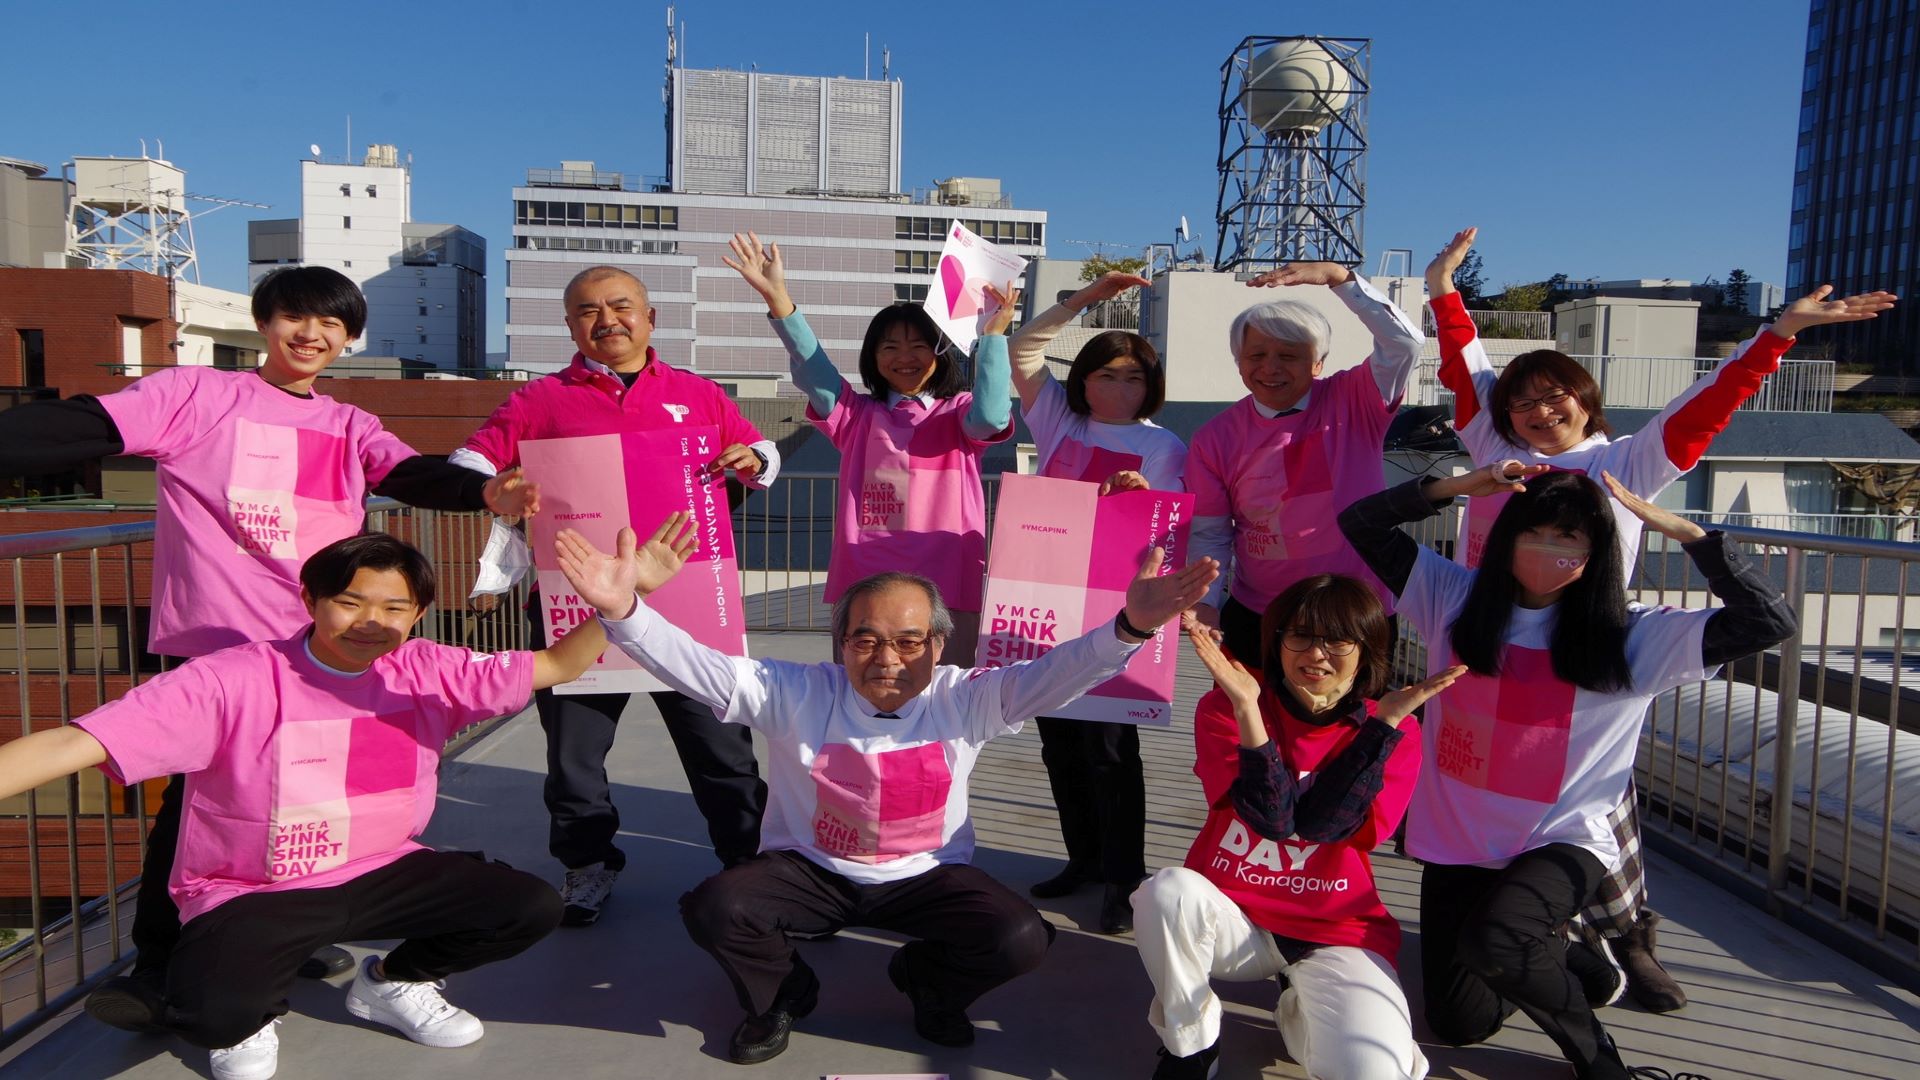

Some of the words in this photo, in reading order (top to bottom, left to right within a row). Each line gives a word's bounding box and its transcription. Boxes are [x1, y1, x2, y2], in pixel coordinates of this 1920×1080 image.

[863, 482, 895, 491] YMCA
[862, 490, 897, 503] PINK
[236, 501, 281, 514] YMCA
[861, 502, 904, 515] SHIRT
[234, 511, 282, 528] PINK
[861, 514, 889, 527] DAY
[237, 525, 291, 543] SHIRT
[1020, 523, 1068, 535] #YMCAPINK
[549, 594, 578, 606] YM
[715, 586, 728, 628] 2023
[550, 607, 597, 626] PIN
[995, 603, 1056, 621] YMCA
[990, 617, 1057, 642] PINK
[986, 638, 1054, 660] SHIR
[1127, 710, 1150, 719] YMCA
[1439, 740, 1485, 771] SHIRT
[1437, 753, 1464, 777] DAY
[278, 820, 329, 833] YMCA
[816, 819, 862, 847] PINK
[275, 829, 330, 848] PINK
[1219, 818, 1320, 872] DAY
[273, 842, 343, 862] SHIRT
[272, 860, 317, 877] DAY
[1211, 851, 1230, 872] in
[1235, 860, 1349, 895] Kanagawa
